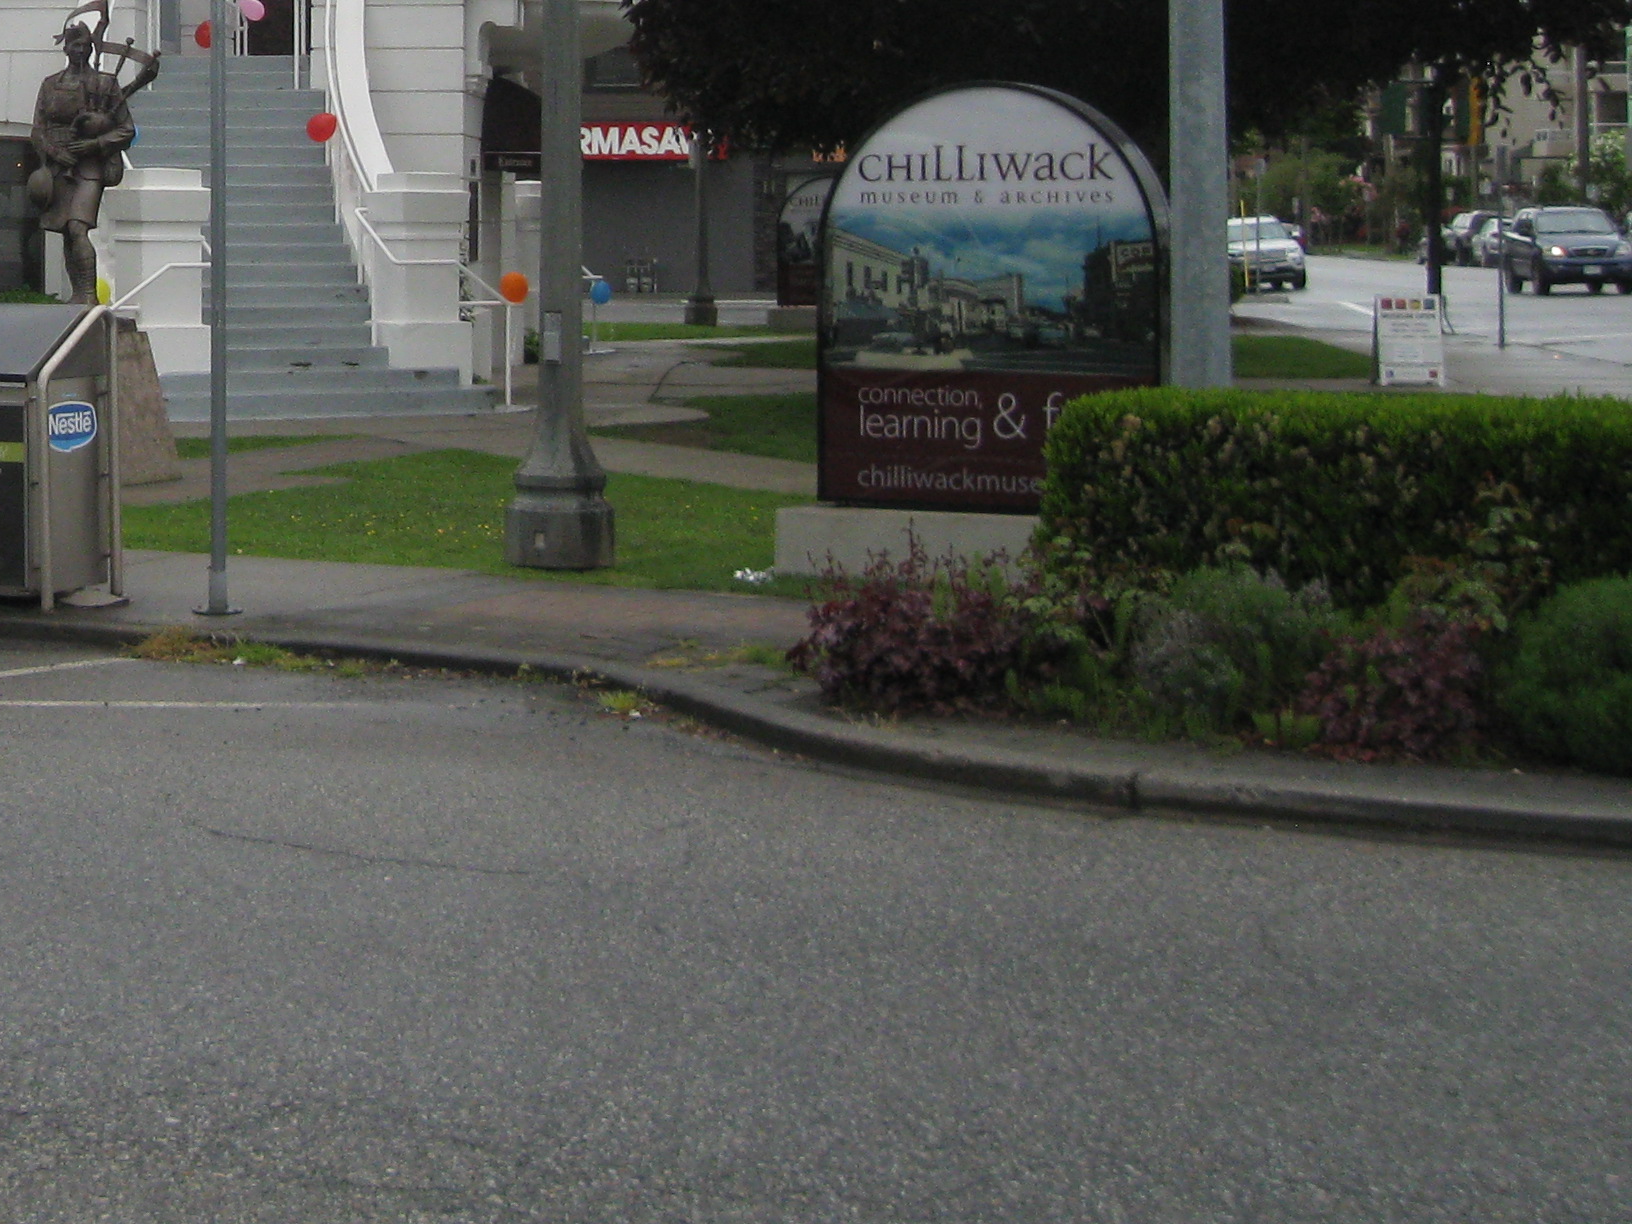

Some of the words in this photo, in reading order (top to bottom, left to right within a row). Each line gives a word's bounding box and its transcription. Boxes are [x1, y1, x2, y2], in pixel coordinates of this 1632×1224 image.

[580, 126, 714, 155] RMASAV
[973, 190, 983, 204] &
[857, 385, 983, 409] connection,
[859, 404, 982, 449] learning
[993, 392, 1027, 439] &
[857, 463, 1043, 495] chilliwackmuse
